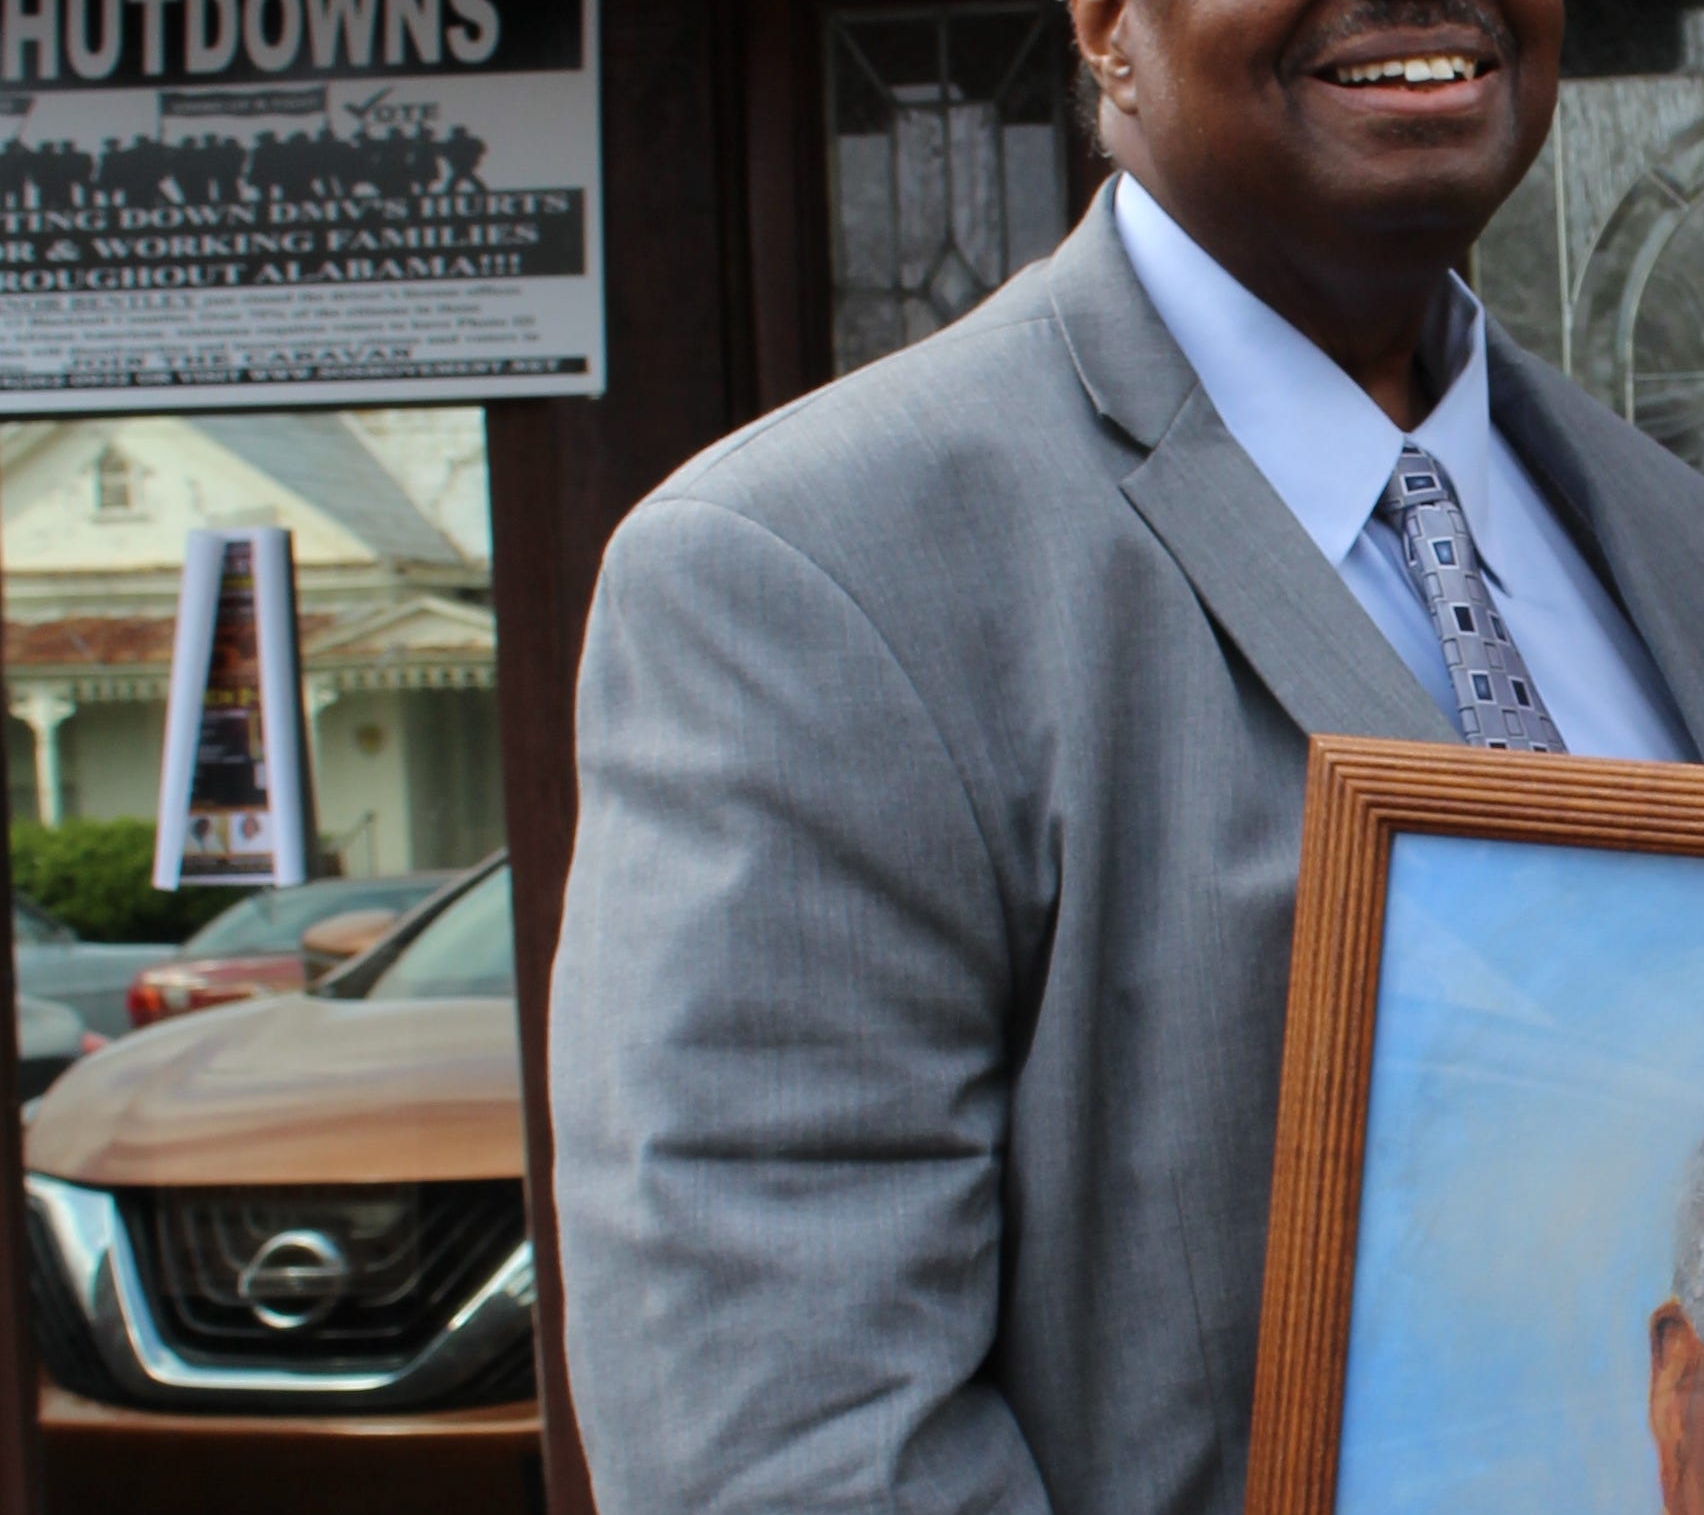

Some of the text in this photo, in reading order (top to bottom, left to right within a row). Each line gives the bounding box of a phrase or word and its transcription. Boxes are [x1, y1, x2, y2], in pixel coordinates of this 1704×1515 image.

[118, 203, 257, 231] DOWN
[418, 192, 570, 218] HURTS
[45, 237, 81, 263] &
[90, 229, 316, 260] WORKING
[325, 222, 541, 253] FAMILIES
